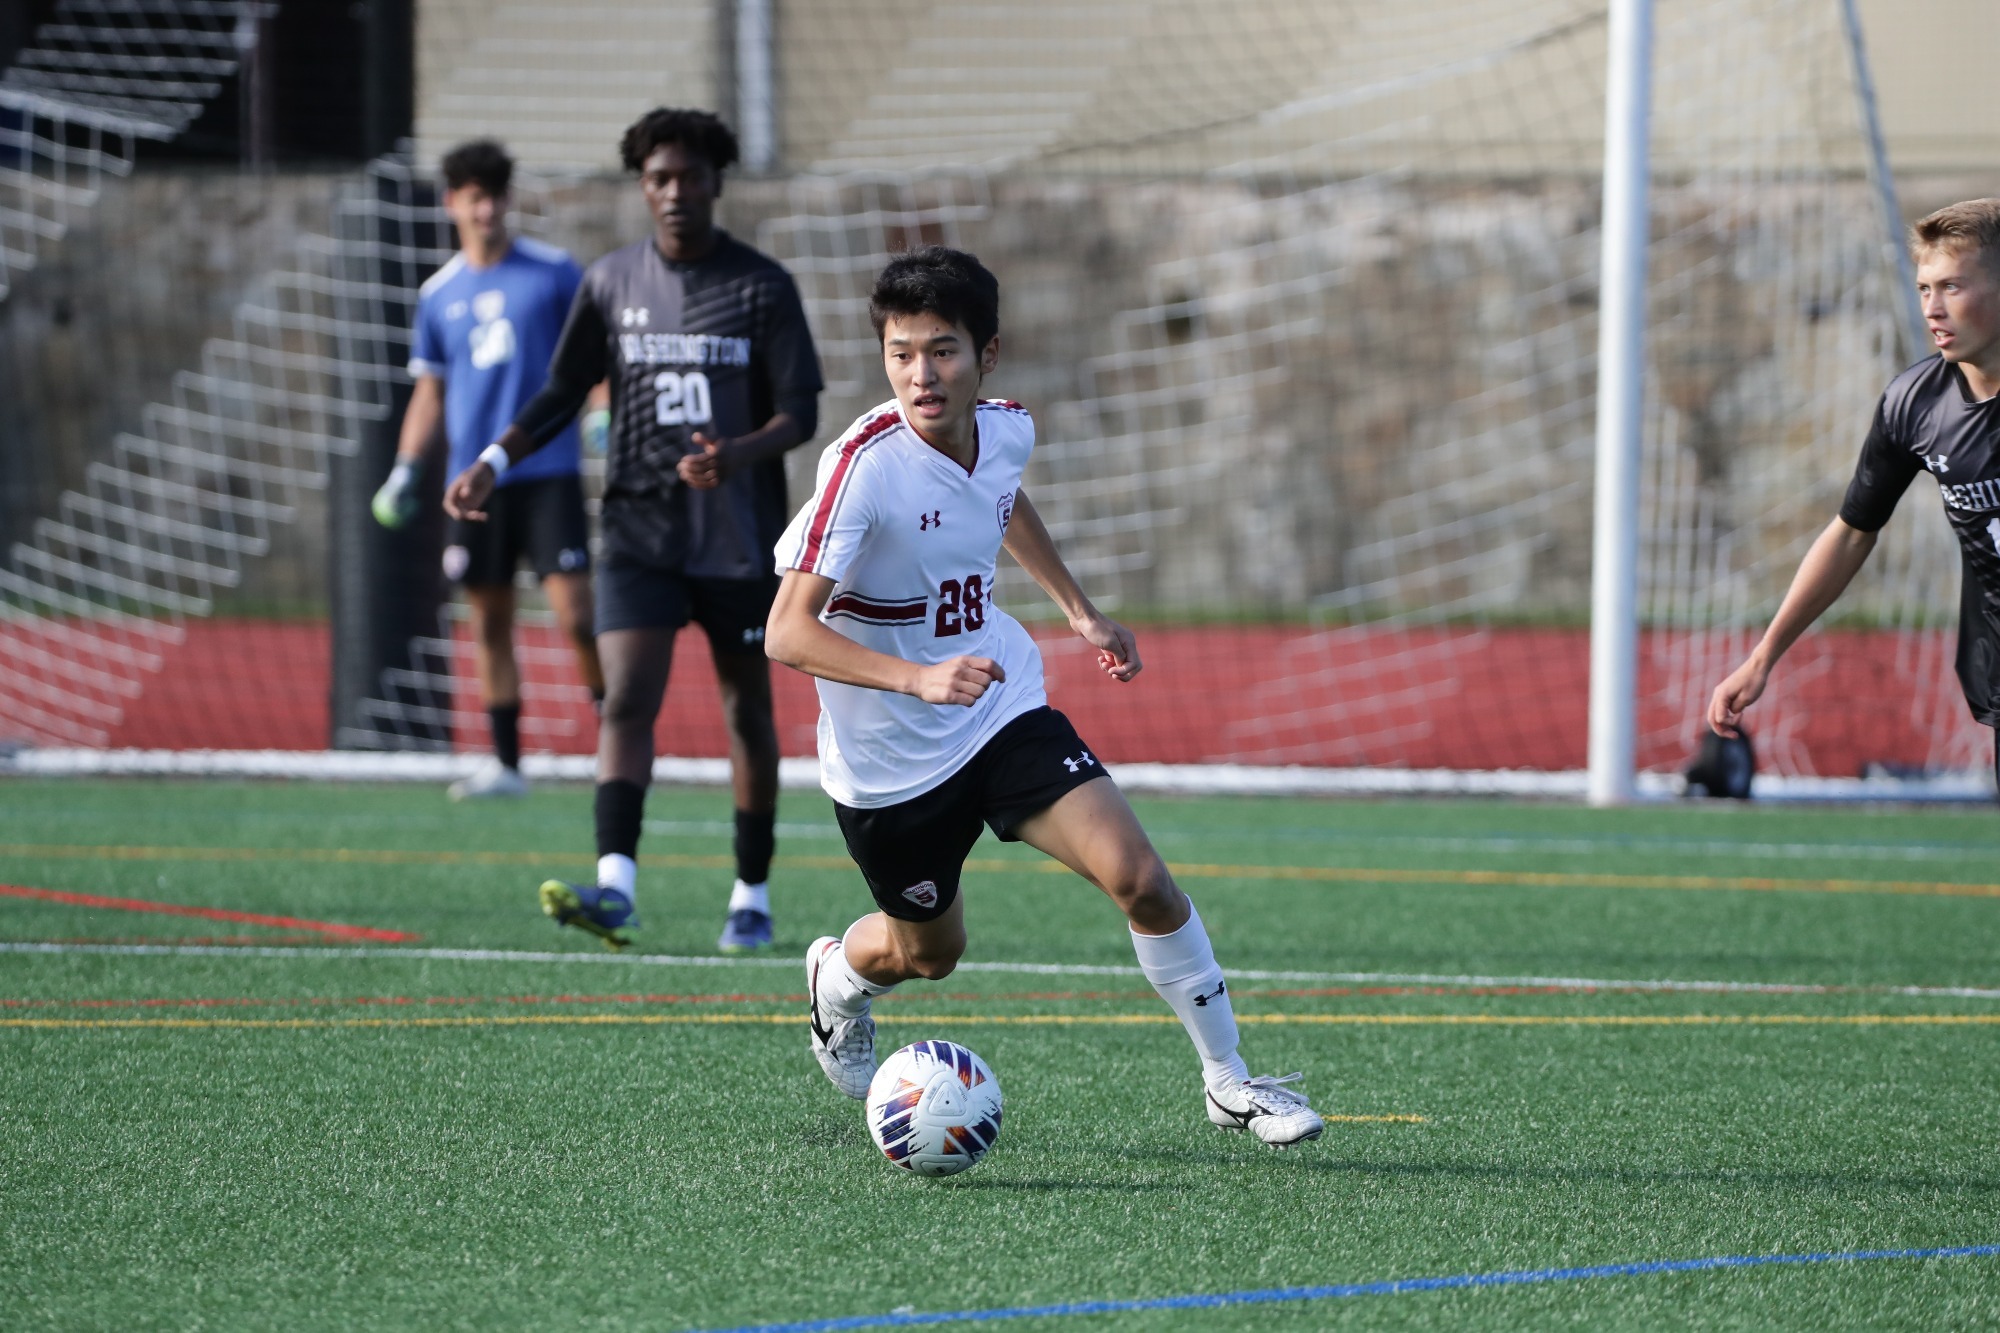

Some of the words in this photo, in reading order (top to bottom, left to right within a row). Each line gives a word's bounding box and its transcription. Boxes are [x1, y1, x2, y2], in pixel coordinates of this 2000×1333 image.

[653, 371, 712, 425] 20
[1940, 478, 2000, 510] SHI
[934, 574, 985, 638] 28
